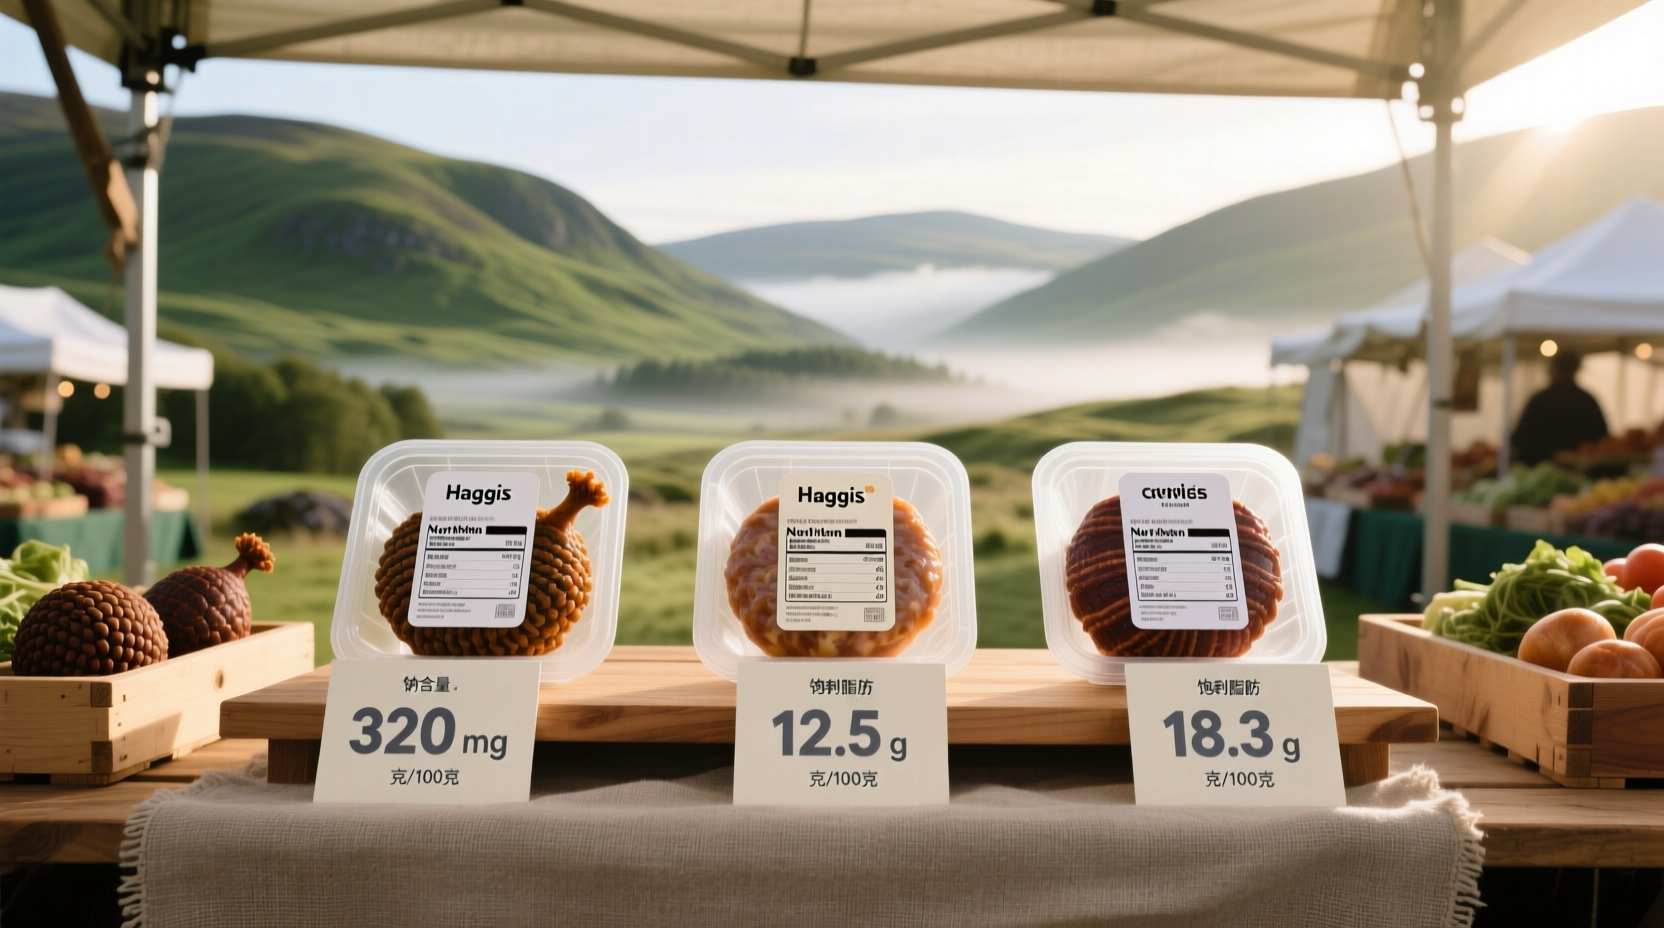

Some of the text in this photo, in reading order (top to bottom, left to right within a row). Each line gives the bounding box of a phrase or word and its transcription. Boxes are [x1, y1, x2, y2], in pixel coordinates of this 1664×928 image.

[446, 484, 511, 505] Haggis
[798, 486, 865, 508] Haggis
[349, 707, 507, 760] 320 mg
[772, 709, 906, 762] 12.5 g
[1163, 710, 1300, 763] 18.3 g
